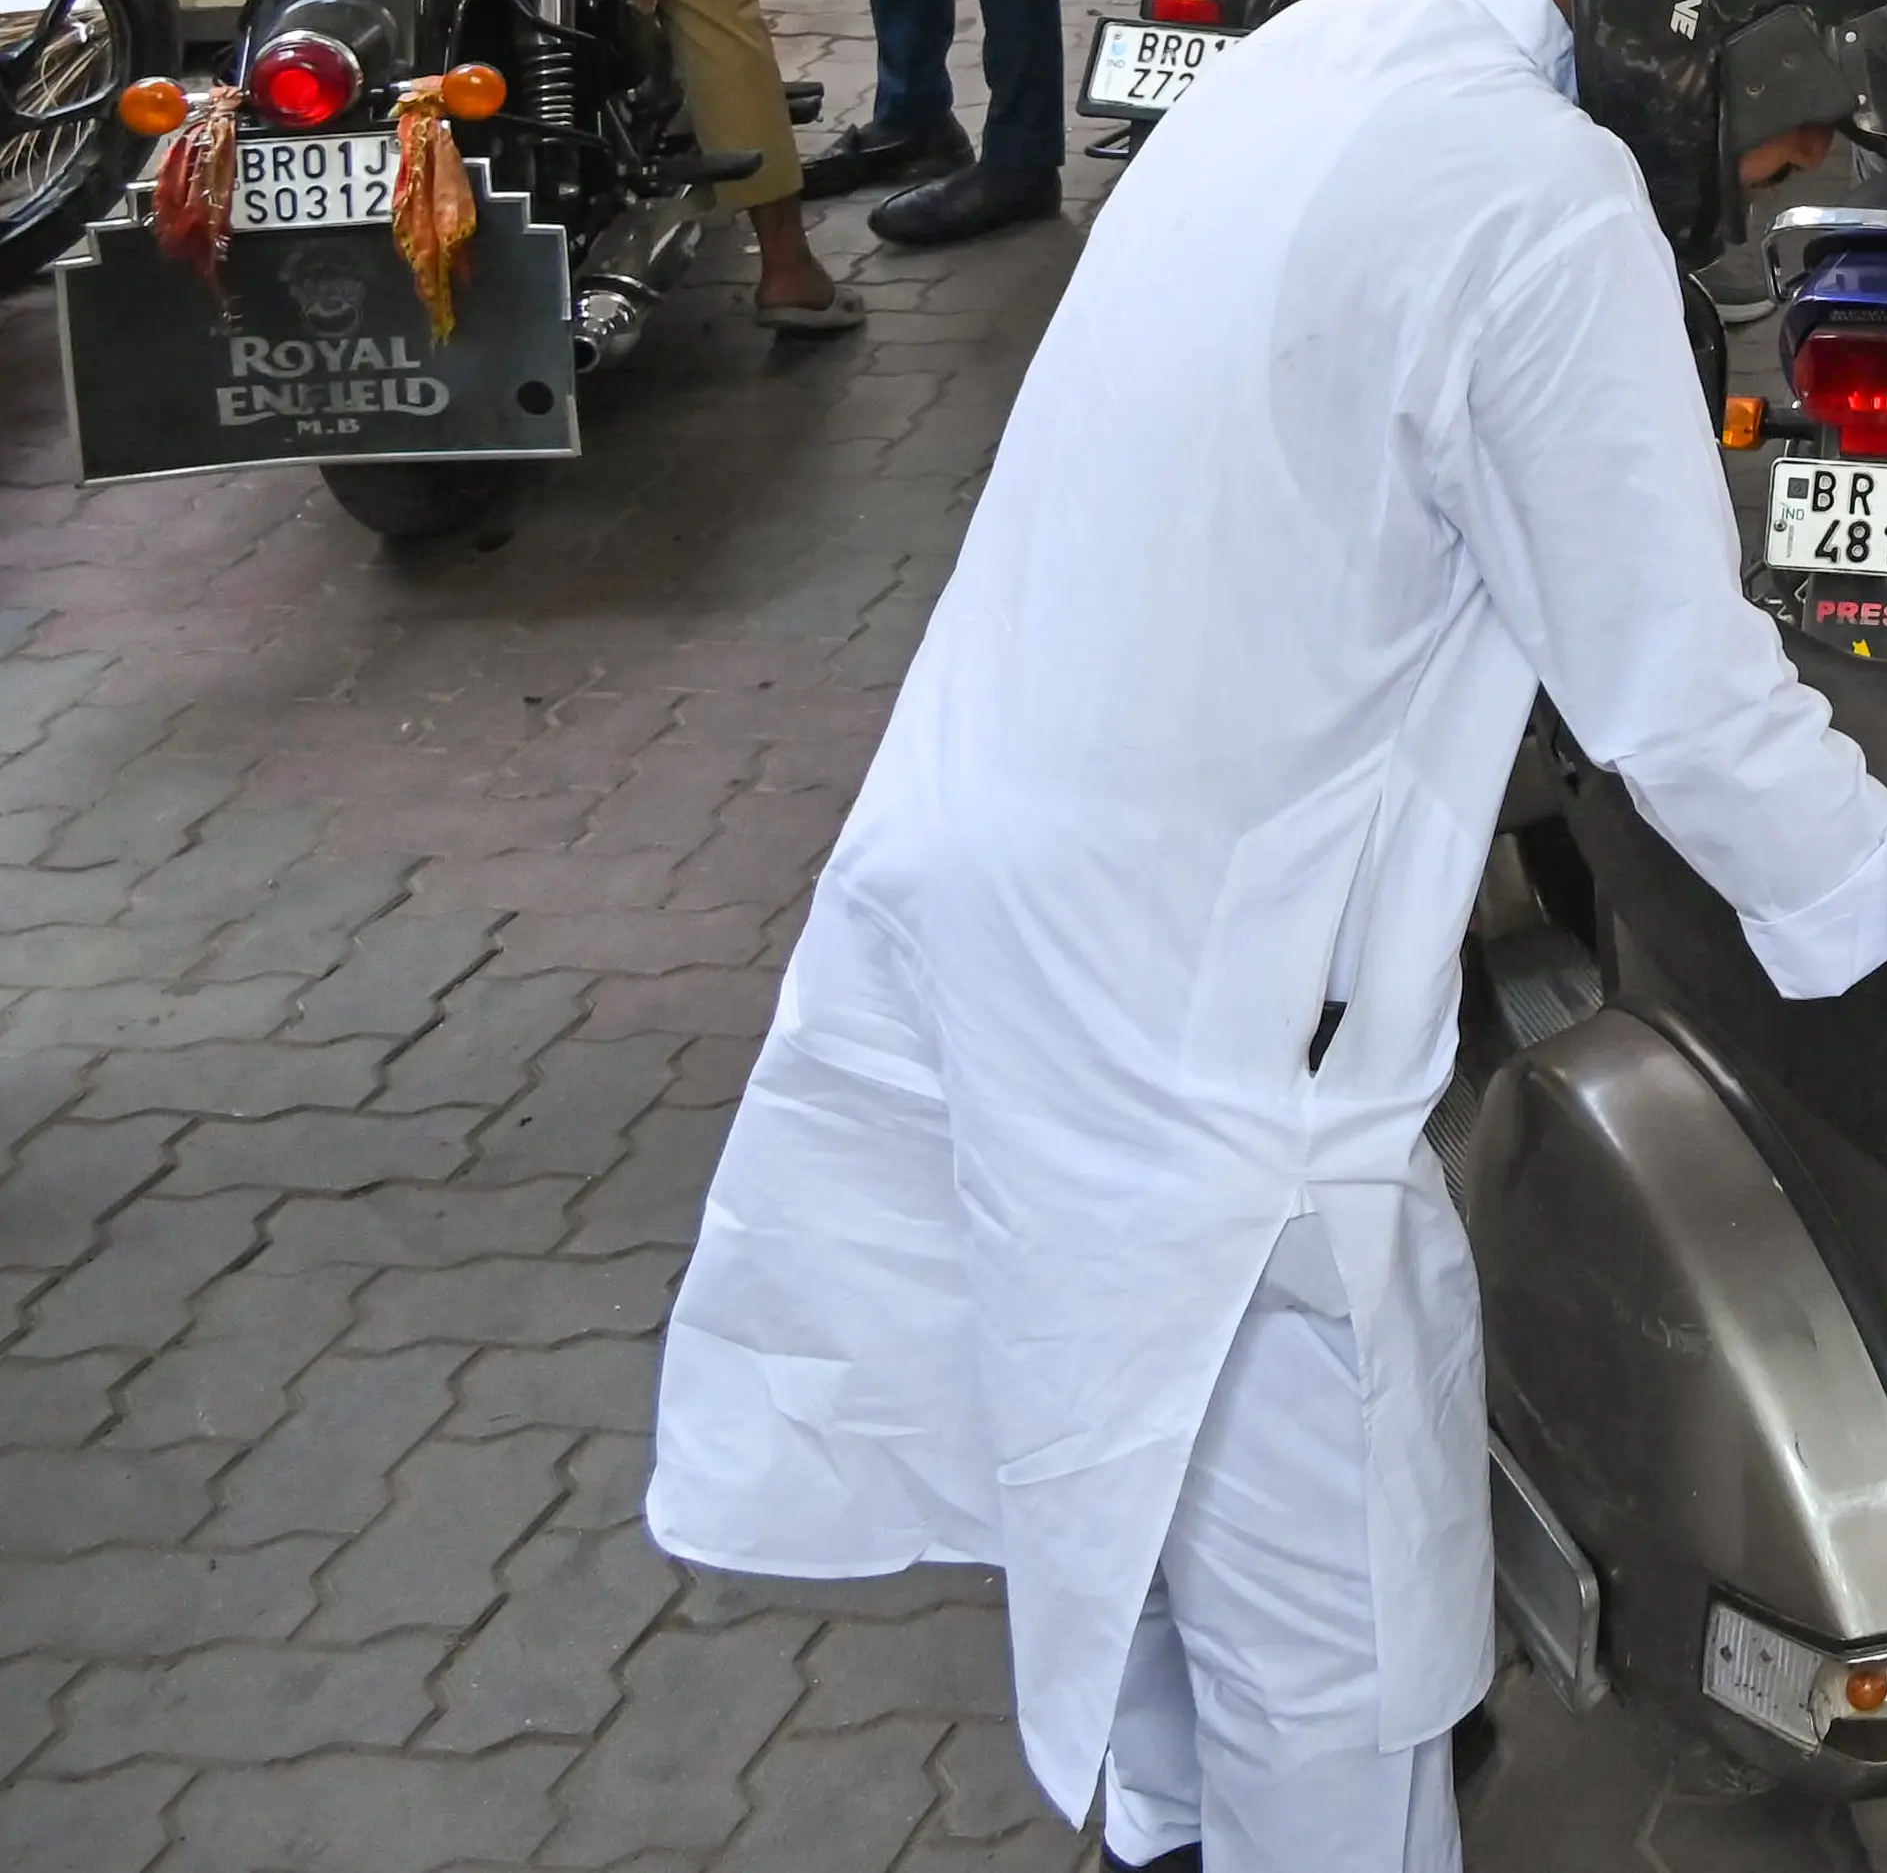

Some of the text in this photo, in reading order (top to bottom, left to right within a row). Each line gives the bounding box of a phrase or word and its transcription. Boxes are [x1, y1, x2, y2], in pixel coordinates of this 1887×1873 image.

[1137, 32, 1228, 68] BR0
[241, 140, 389, 185] BR01J
[244, 181, 391, 224] S0312
[229, 335, 421, 379] ROYAL
[216, 377, 450, 425] ENFIELD
[296, 417, 361, 436] M.B
[1781, 507, 1805, 521] IND
